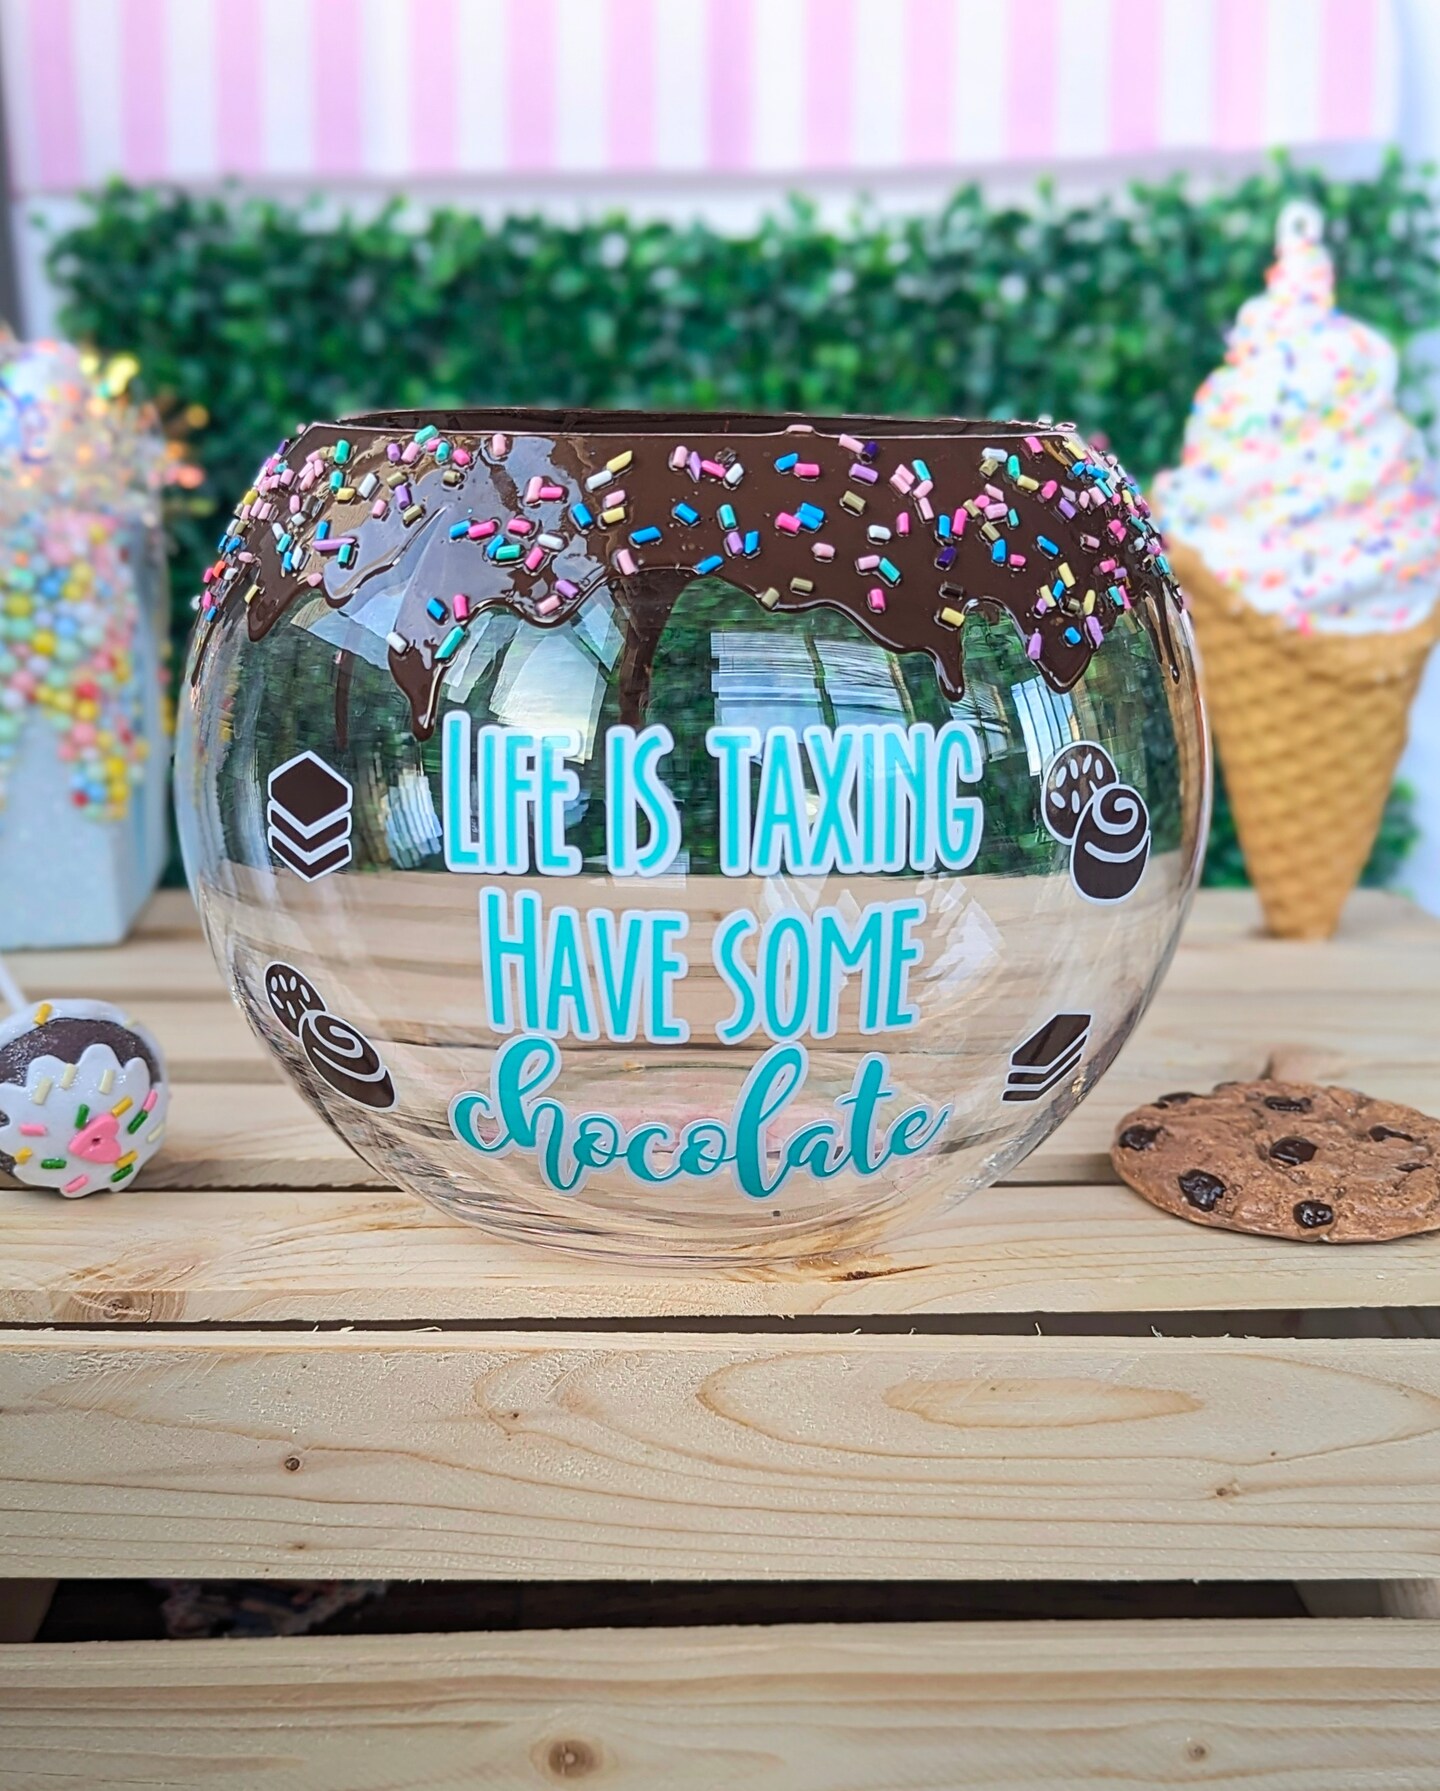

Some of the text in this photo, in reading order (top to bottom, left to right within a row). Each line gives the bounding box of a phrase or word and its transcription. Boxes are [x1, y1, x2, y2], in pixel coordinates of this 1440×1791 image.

[447, 715, 980, 872] LIFE IS TAXING
[485, 890, 922, 1041] HAVE SOME
[451, 1037, 952, 1195] chocolate
